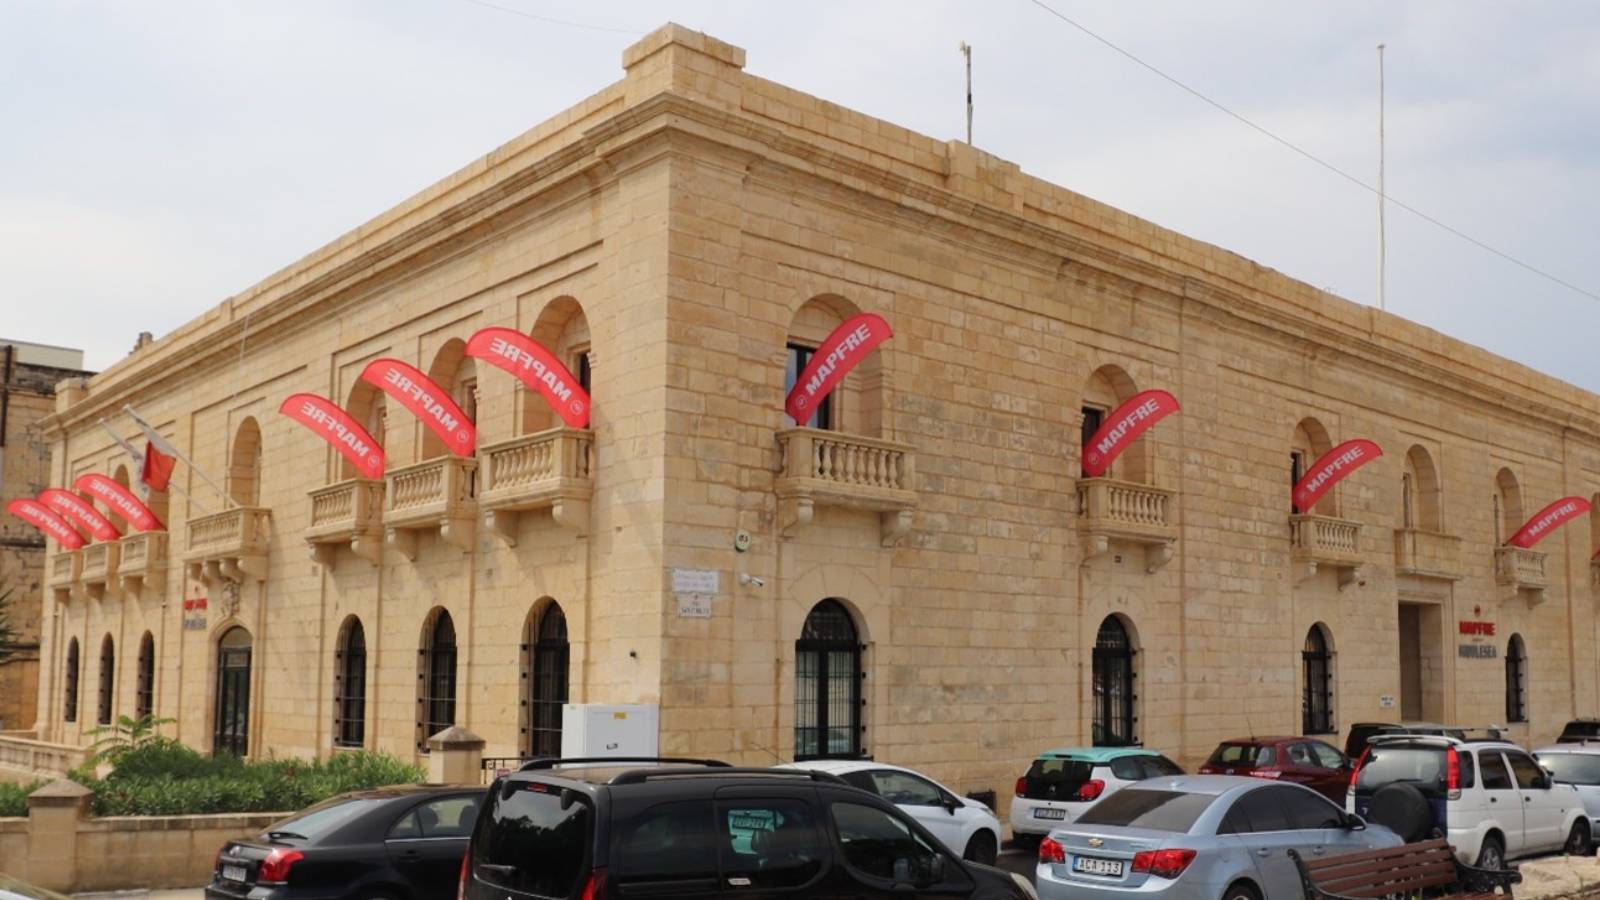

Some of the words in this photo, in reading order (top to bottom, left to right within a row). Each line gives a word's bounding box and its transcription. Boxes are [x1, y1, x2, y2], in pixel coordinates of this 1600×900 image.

[806, 323, 872, 396] MAPFRE
[1097, 398, 1160, 454] MAPFRE
[1306, 446, 1364, 493] MAPFRE
[1528, 502, 1577, 536] MAPFRE
